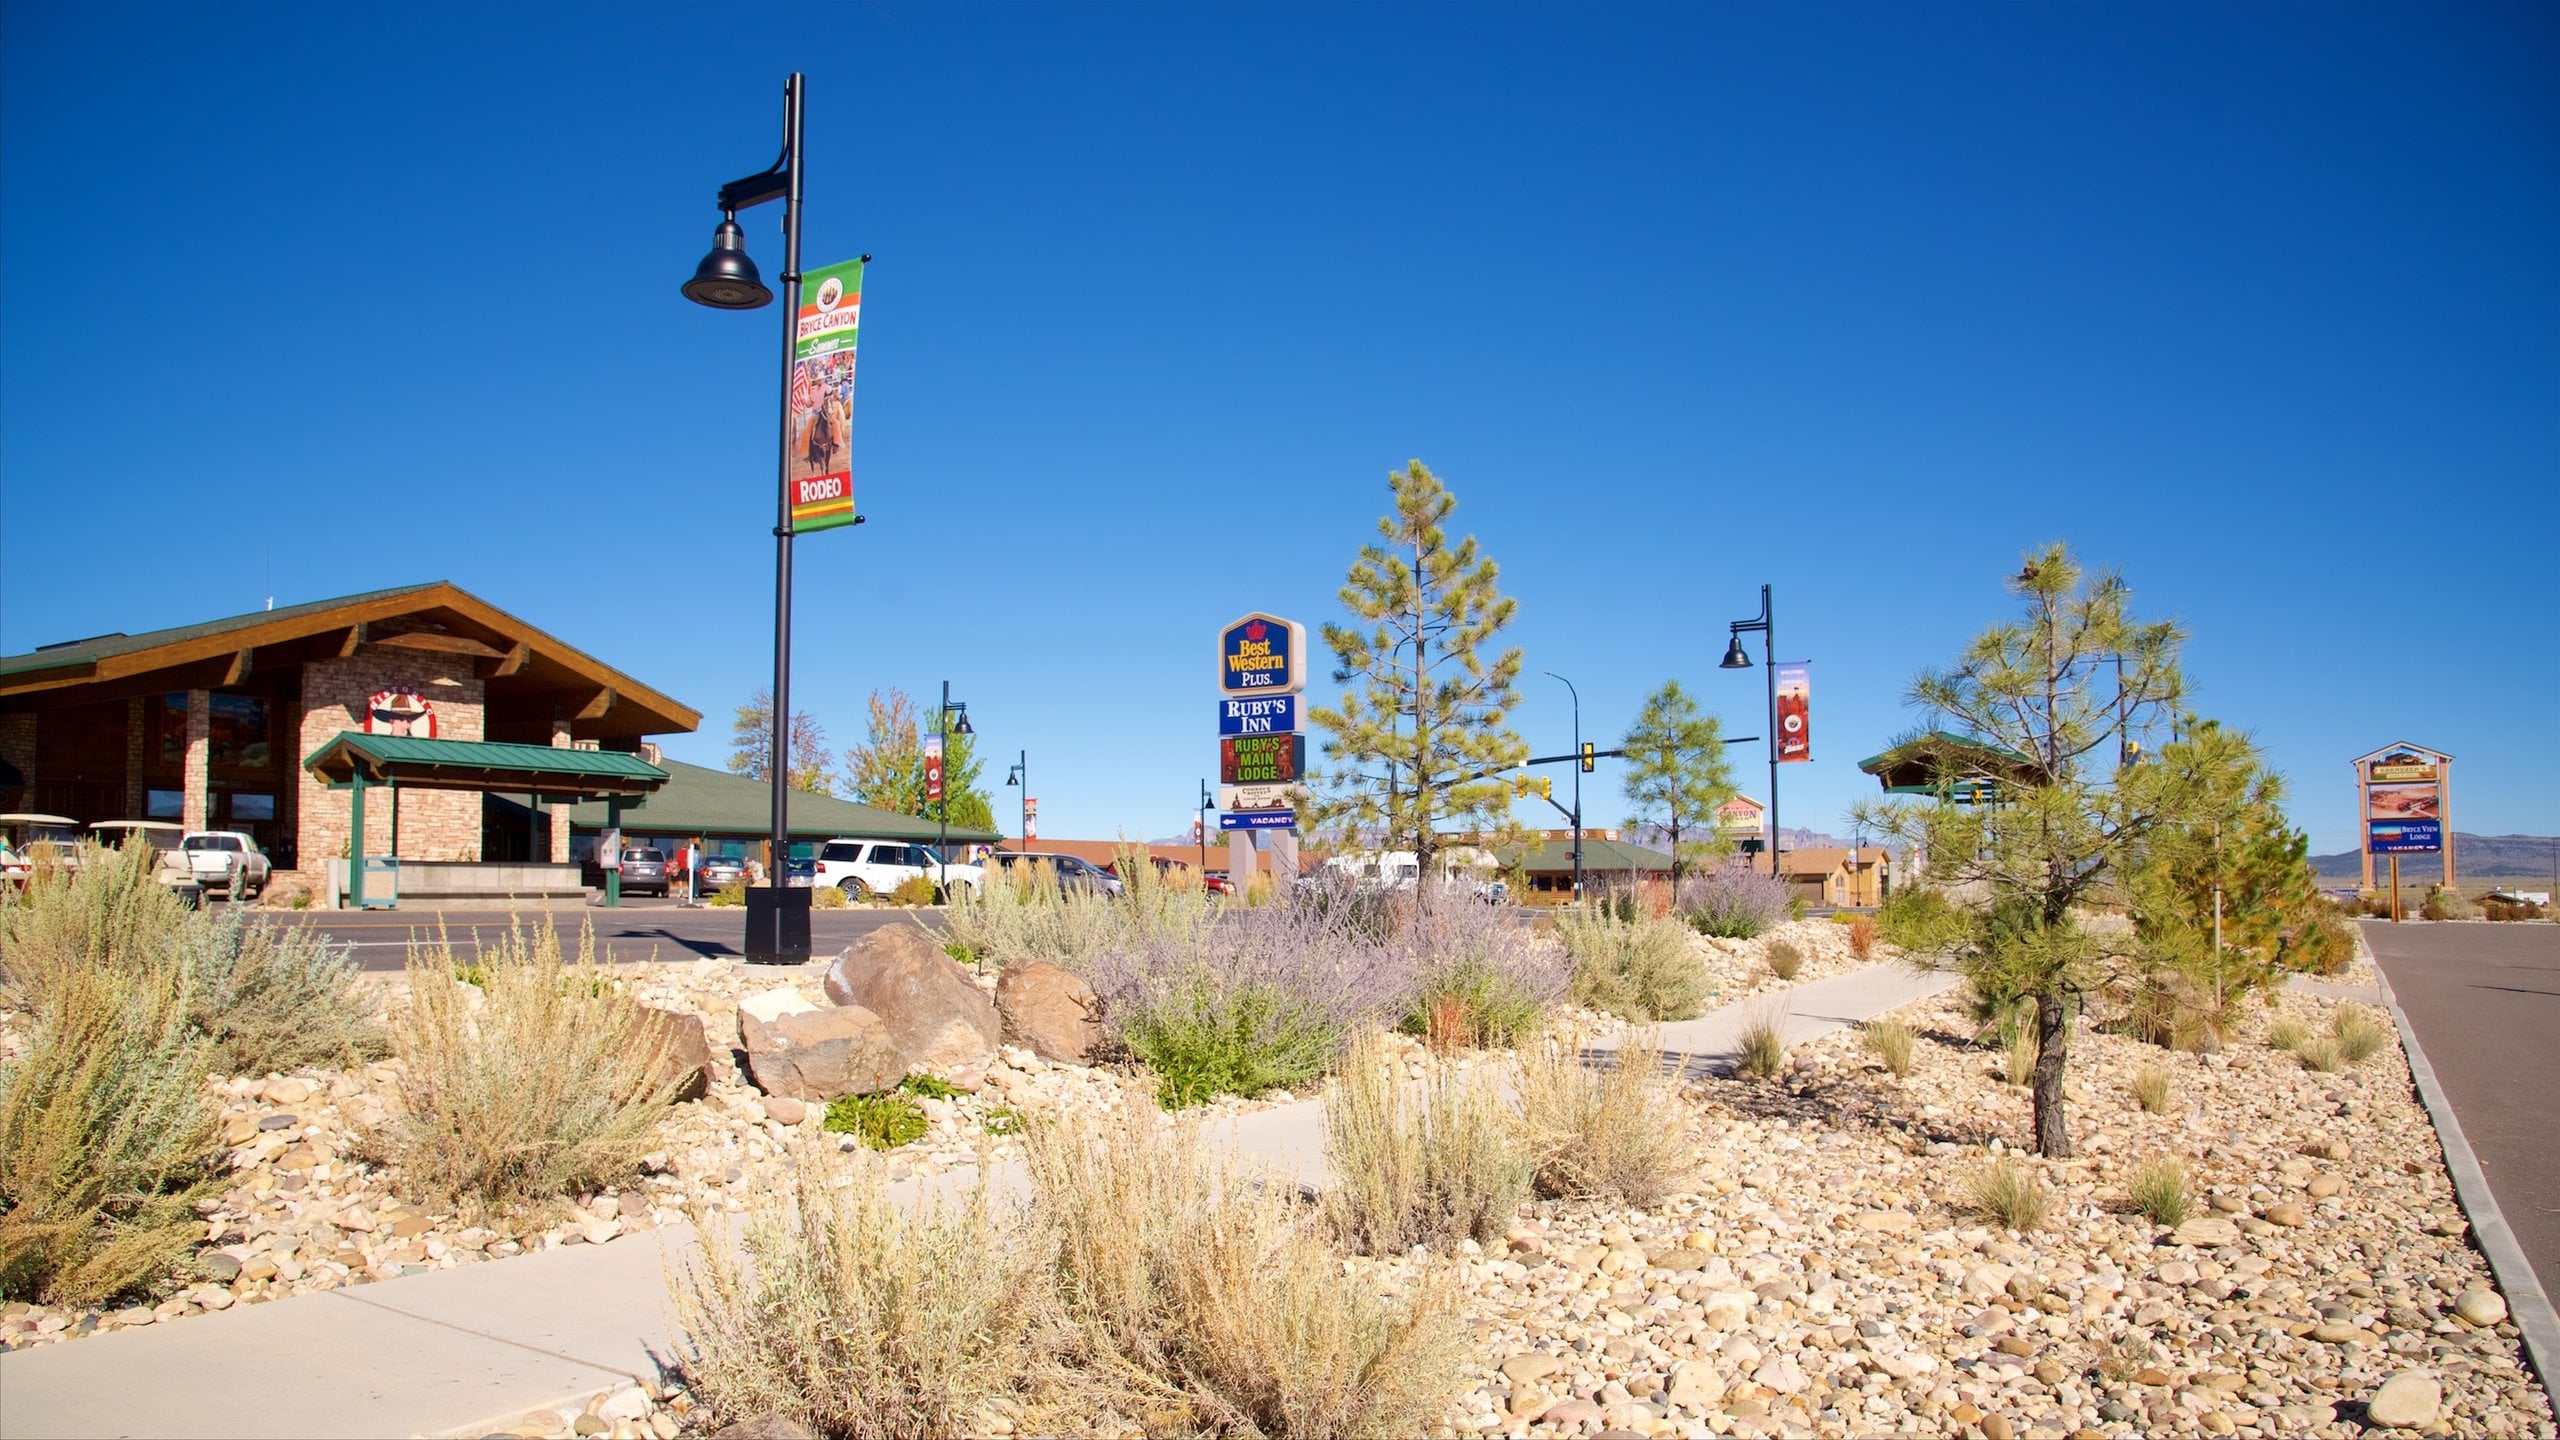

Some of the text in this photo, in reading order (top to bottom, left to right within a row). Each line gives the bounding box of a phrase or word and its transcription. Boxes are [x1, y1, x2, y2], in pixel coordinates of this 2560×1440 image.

[800, 311, 857, 337] BRYCE CANYON
[800, 477, 842, 503] RODEO
[1239, 638, 1271, 656] Best
[1228, 655, 1284, 672] Western
[369, 686, 433, 715] HISTORIC
[1227, 699, 1286, 717] RUBY'S
[1241, 717, 1272, 733] INN
[1235, 738, 1280, 752] RUBY'S
[1240, 752, 1274, 766] MAIN
[1237, 766, 1278, 780] LODGE
[1250, 816, 1293, 825] VACANCY
